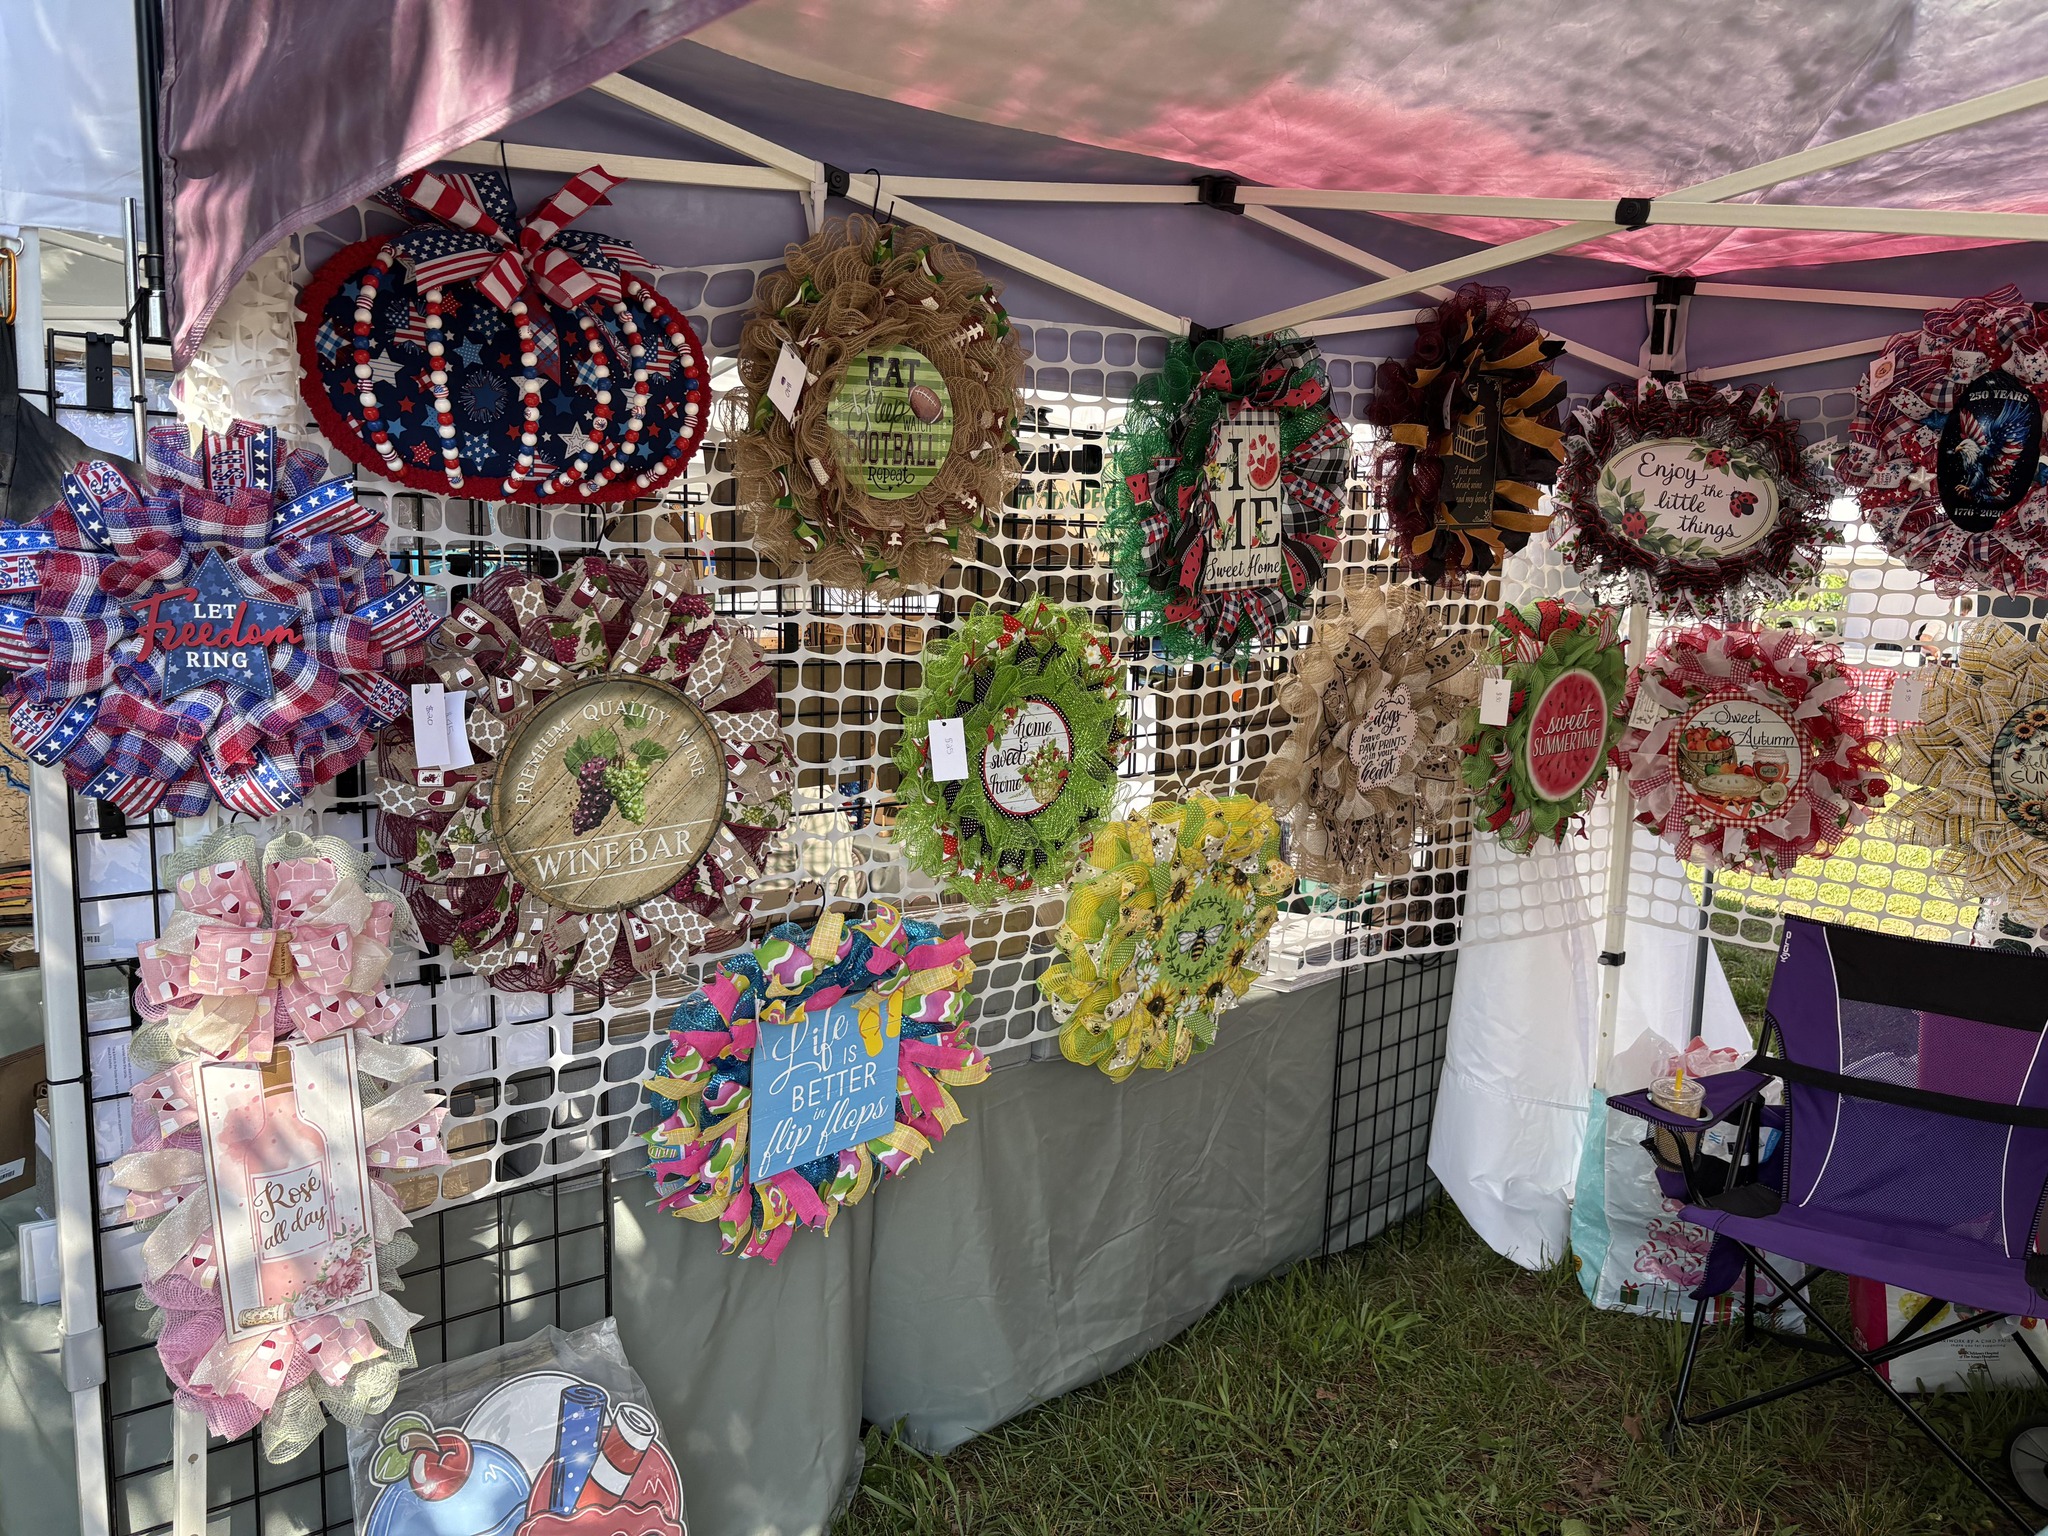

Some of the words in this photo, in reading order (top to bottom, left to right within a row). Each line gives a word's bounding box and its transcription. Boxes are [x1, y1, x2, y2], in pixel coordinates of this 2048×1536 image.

[866, 356, 921, 387] EAT
[1969, 390, 1989, 402] 250
[1993, 389, 2030, 403] YEARS
[846, 429, 936, 467] FOOTBALL
[867, 466, 915, 488] Repeat
[1456, 466, 1469, 480] just
[1468, 465, 1482, 475] want
[1456, 477, 1471, 490] drink
[1470, 480, 1483, 489] wine
[1637, 452, 1709, 489] Enjoy
[1466, 495, 1475, 508] my
[1654, 490, 1707, 513] little
[1701, 484, 1724, 499] the
[1953, 507, 1974, 517] 1776
[1677, 514, 1741, 544] things
[1205, 555, 1244, 581] Sweet
[1244, 554, 1281, 579] Home
[134, 587, 304, 662] Freedom
[194, 603, 237, 620] LET
[186, 651, 249, 669] RING
[582, 699, 672, 729] QUALITY
[1012, 714, 1053, 737] home
[1373, 707, 1405, 735] dogs
[1540, 704, 1601, 736] sweet
[1714, 704, 1762, 727] Sweet
[1358, 742, 1378, 755] PAW
[1378, 735, 1407, 750] PRINTS
[1360, 732, 1381, 744] leave
[1532, 727, 1601, 757] SUMMERTIME
[1728, 726, 1796, 749] Autumn
[515, 718, 573, 806] PREMIUM
[675, 729, 707, 779] WINE
[989, 735, 1028, 770] sweet
[1368, 750, 1376, 760] in
[1377, 748, 1394, 760] your
[1360, 755, 1398, 783] heart
[989, 773, 1022, 796] home
[531, 841, 623, 883] WINE
[628, 829, 694, 865] BAR
[1779, 930, 1793, 963] Kijaro
[768, 1007, 850, 1096] Life
[843, 1044, 858, 1064] IS
[791, 1061, 877, 1114] BETTER
[813, 1105, 828, 1121] in
[757, 1115, 814, 1179] flip
[816, 1094, 890, 1157] flops
[253, 1169, 322, 1224] Rosé
[264, 1218, 291, 1252] all
[290, 1204, 329, 1236] day
